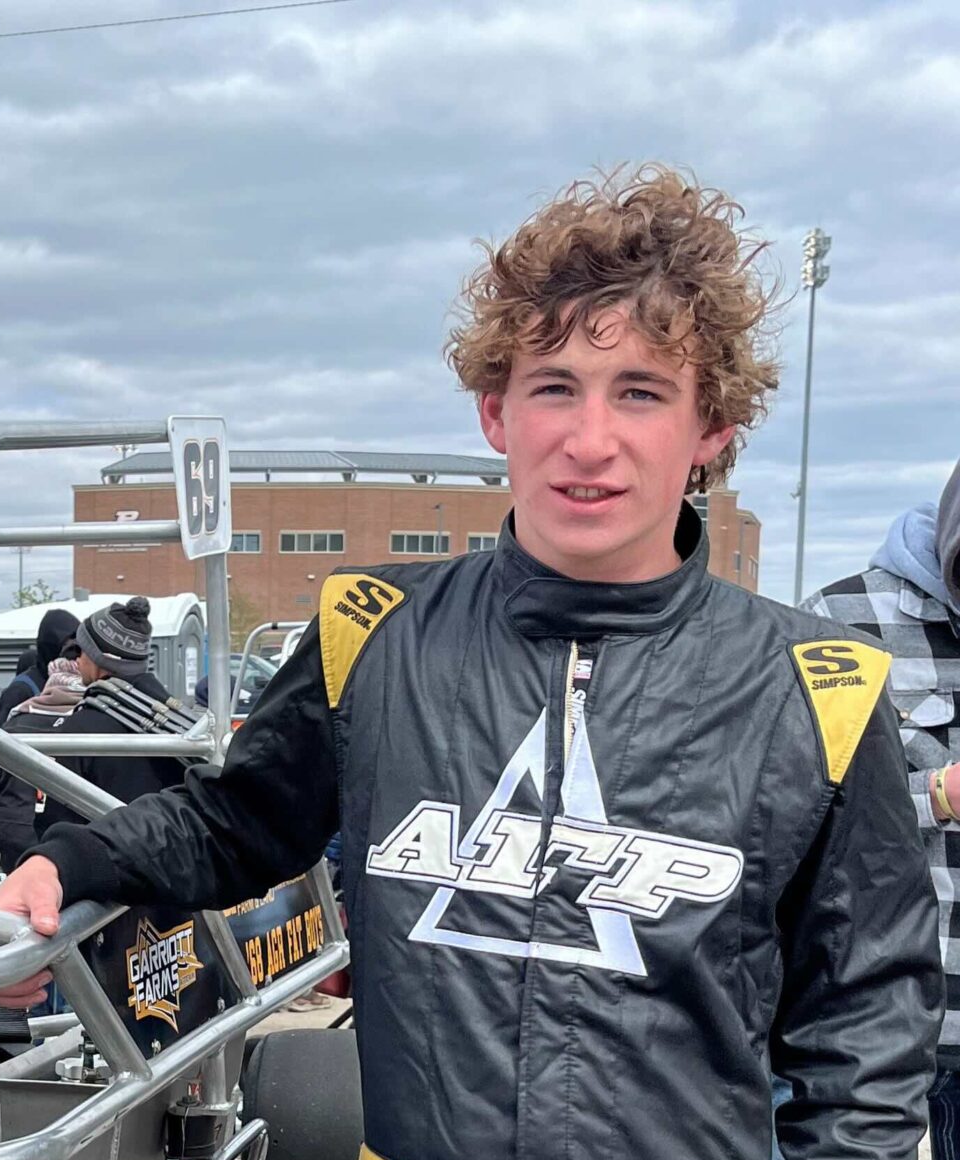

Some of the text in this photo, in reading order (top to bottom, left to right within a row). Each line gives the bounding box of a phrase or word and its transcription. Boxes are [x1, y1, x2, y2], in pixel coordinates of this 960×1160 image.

[182, 438, 220, 538] 69
[334, 601, 372, 630] SIMPSON
[811, 676, 863, 690] SIMPSON
[129, 928, 192, 983] GARRIOTT
[286, 915, 304, 965] FAT
[135, 963, 179, 1012] FARMS
